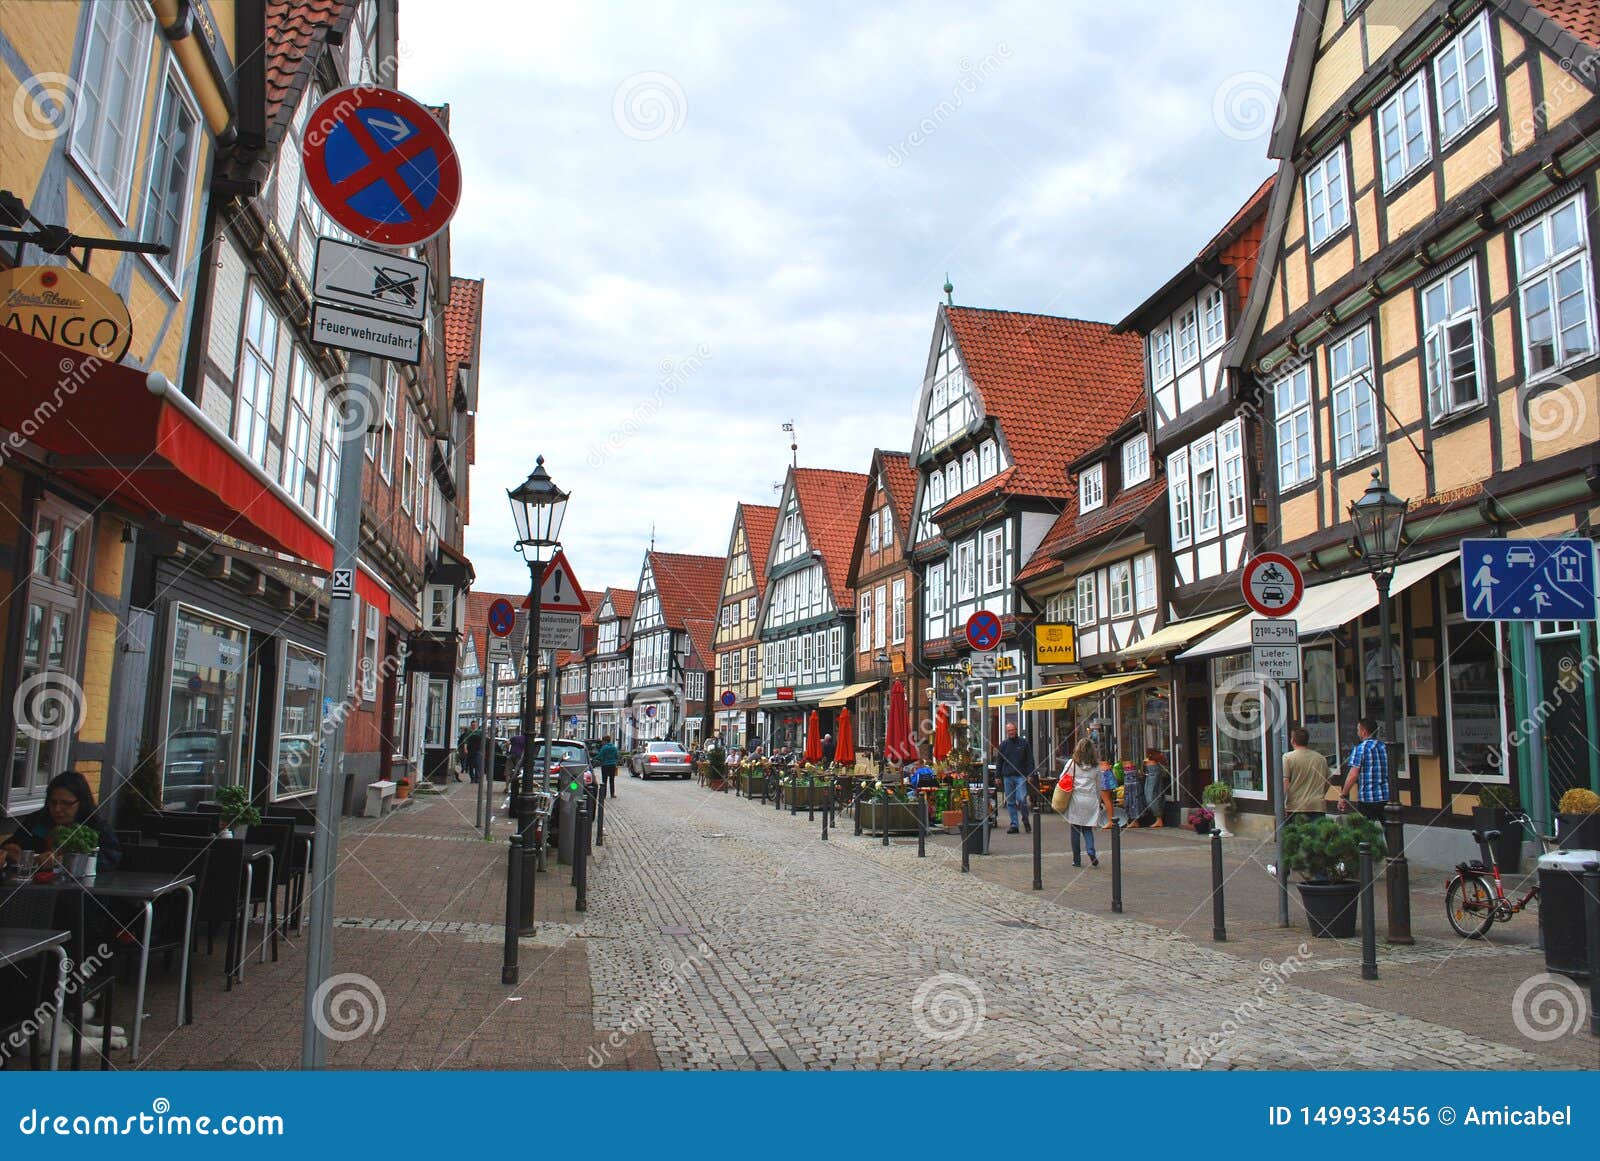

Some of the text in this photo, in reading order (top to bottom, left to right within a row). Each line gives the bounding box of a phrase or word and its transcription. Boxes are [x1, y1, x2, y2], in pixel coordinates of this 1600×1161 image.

[1039, 646, 1072, 654] GAJAH
[1261, 649, 1290, 658] Liefer-
[1270, 669, 1284, 677] frei
